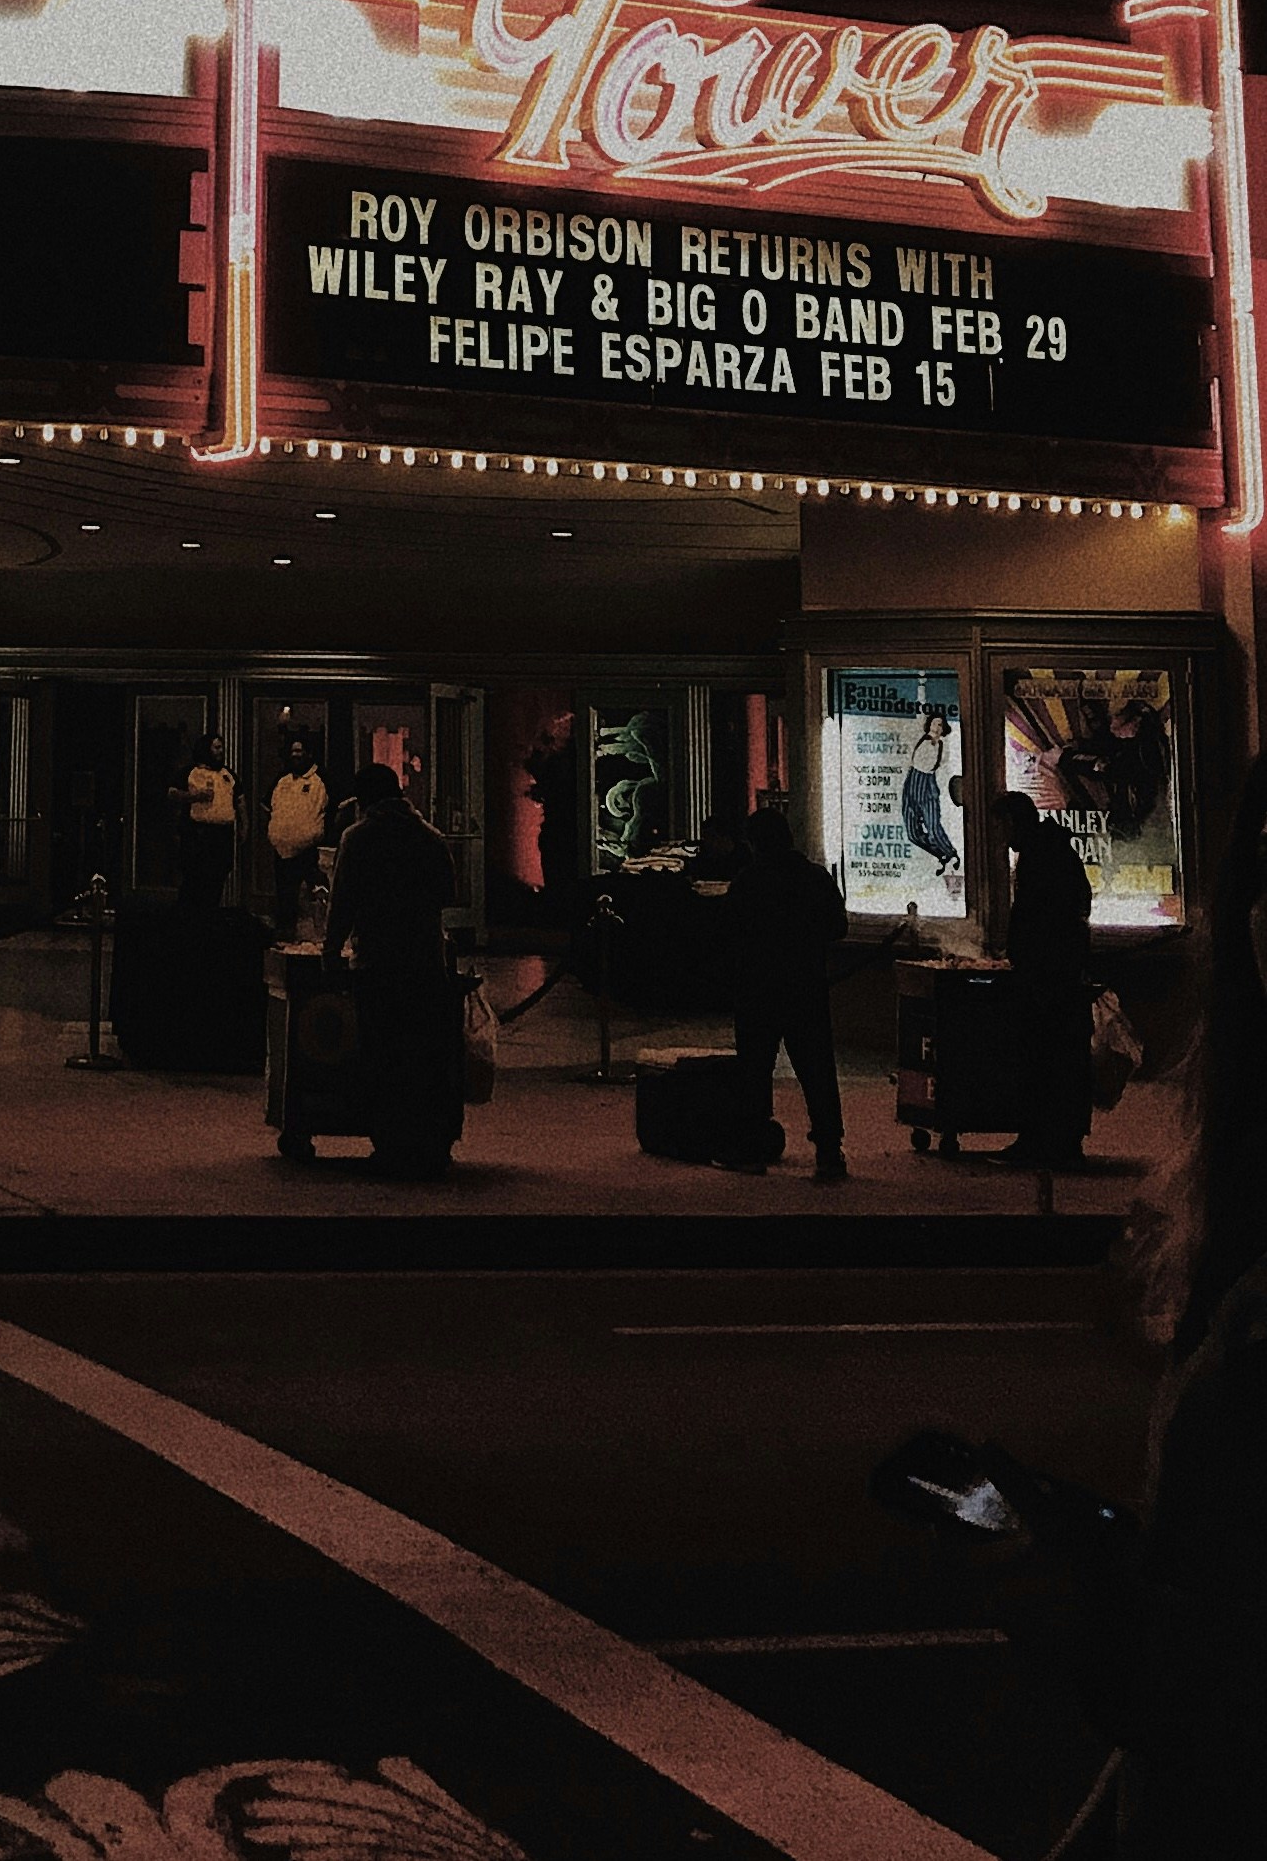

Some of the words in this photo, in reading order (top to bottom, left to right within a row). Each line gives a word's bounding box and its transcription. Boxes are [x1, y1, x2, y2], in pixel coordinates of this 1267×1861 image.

[350, 190, 437, 245] ROY
[464, 203, 652, 268] ORBISON
[681, 225, 872, 288] RETURNS
[896, 246, 994, 301] WITH
[308, 245, 447, 305] WILEY
[475, 261, 564, 316] RAY
[591, 274, 619, 322] &
[647, 278, 717, 331] BIG
[742, 289, 768, 335] O
[795, 292, 905, 347] BAND
[932, 305, 1003, 355] FEB
[1025, 314, 1067, 362] 29
[429, 315, 575, 376] FELIPE
[601, 332, 797, 394] ESPARZA
[820, 351, 892, 402] FEB
[915, 360, 956, 407] 15
[844, 682, 898, 700] Paula
[844, 697, 959, 717] Poundstone
[853, 732, 901, 742] ATURDAY
[896, 744, 909, 755] 22
[858, 776, 891, 786] 630PM
[859, 802, 892, 813] 730PM
[852, 824, 904, 840] TOWER
[848, 842, 912, 858] THEATRE
